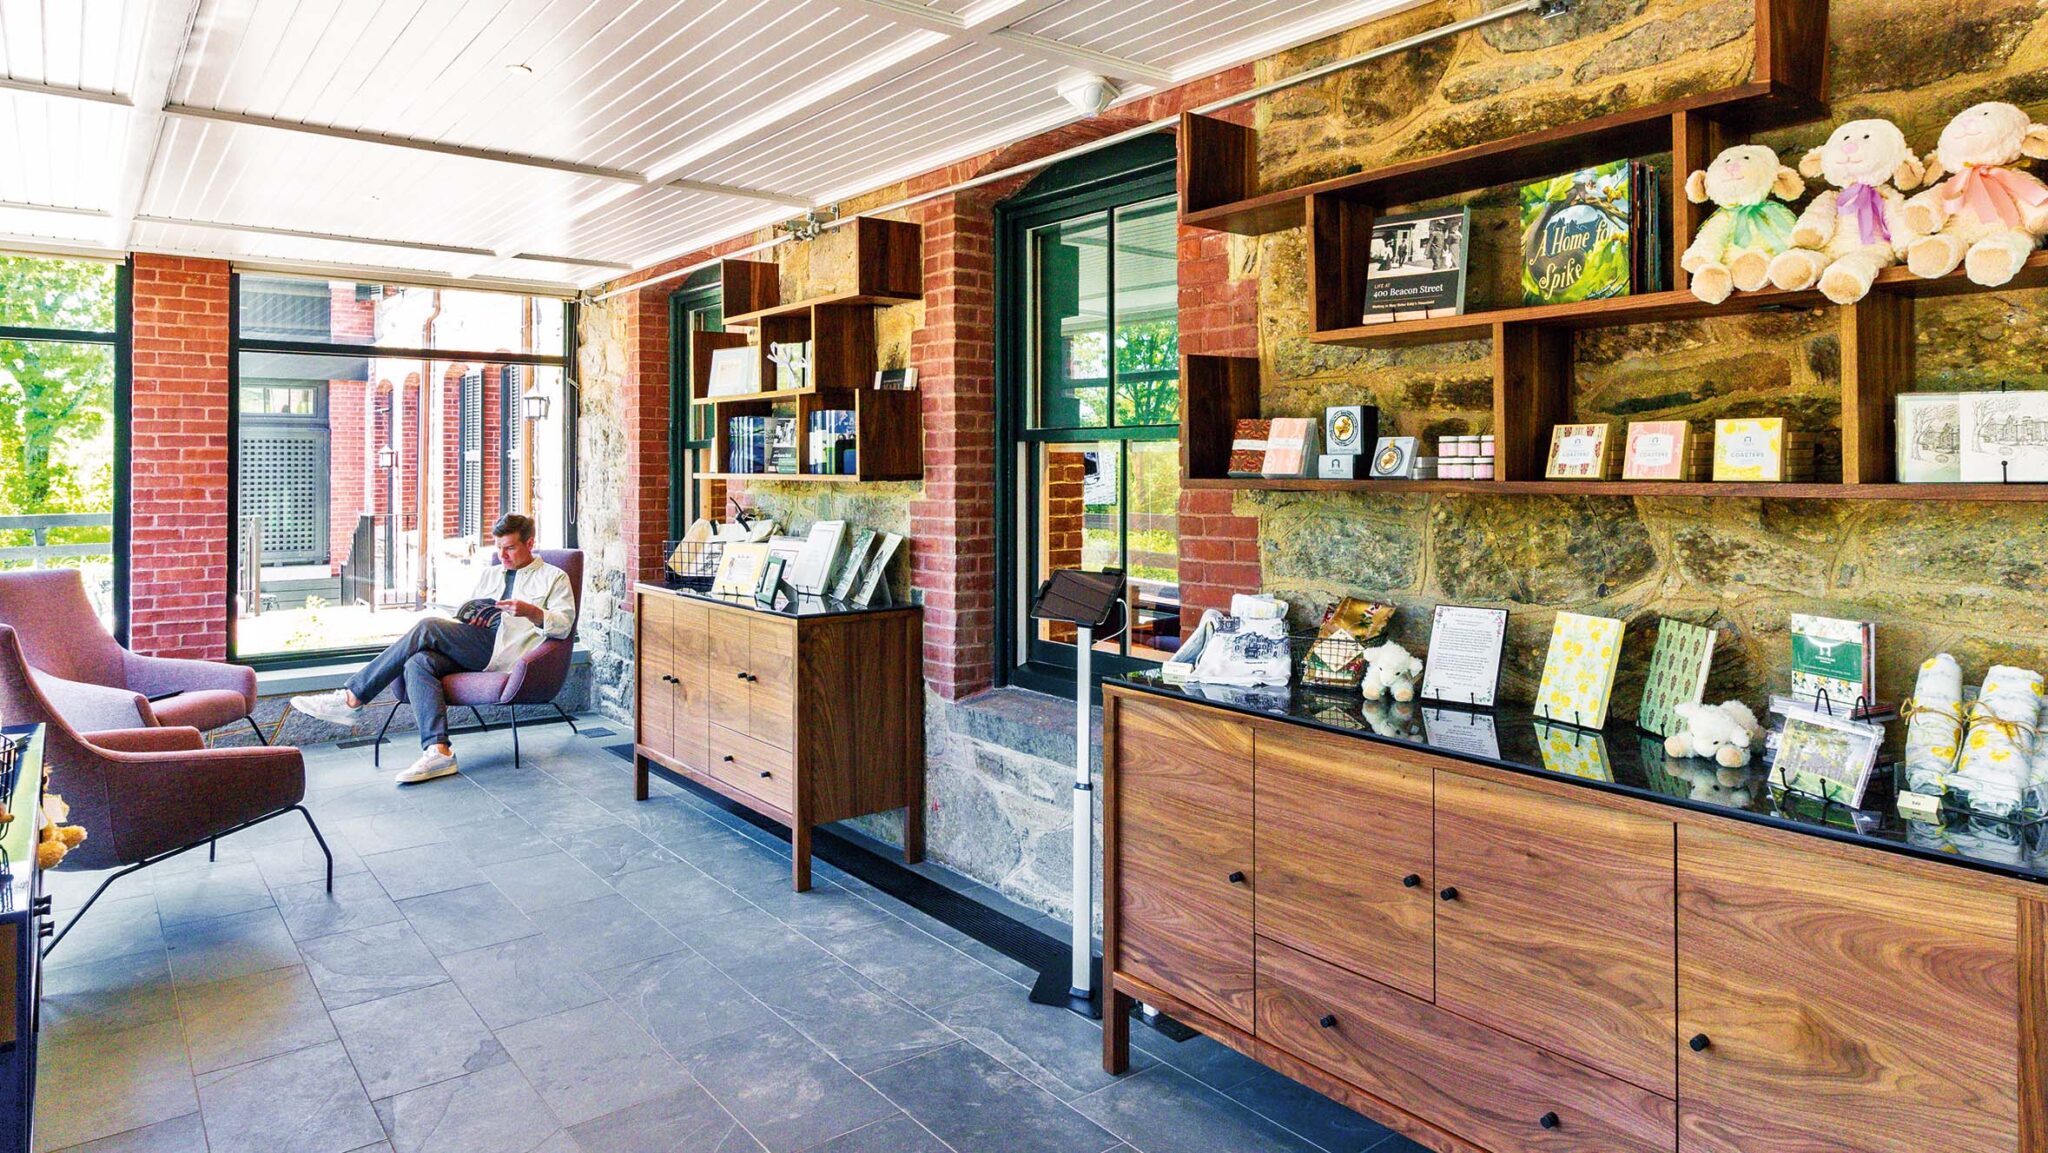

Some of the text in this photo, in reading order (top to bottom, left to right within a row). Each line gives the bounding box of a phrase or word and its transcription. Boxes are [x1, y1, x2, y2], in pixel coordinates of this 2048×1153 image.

[1529, 229, 1547, 265] A
[1551, 226, 1590, 255] Home
[1373, 283, 1443, 298] 400 Beacon Street
[1538, 257, 1582, 300] Spike
